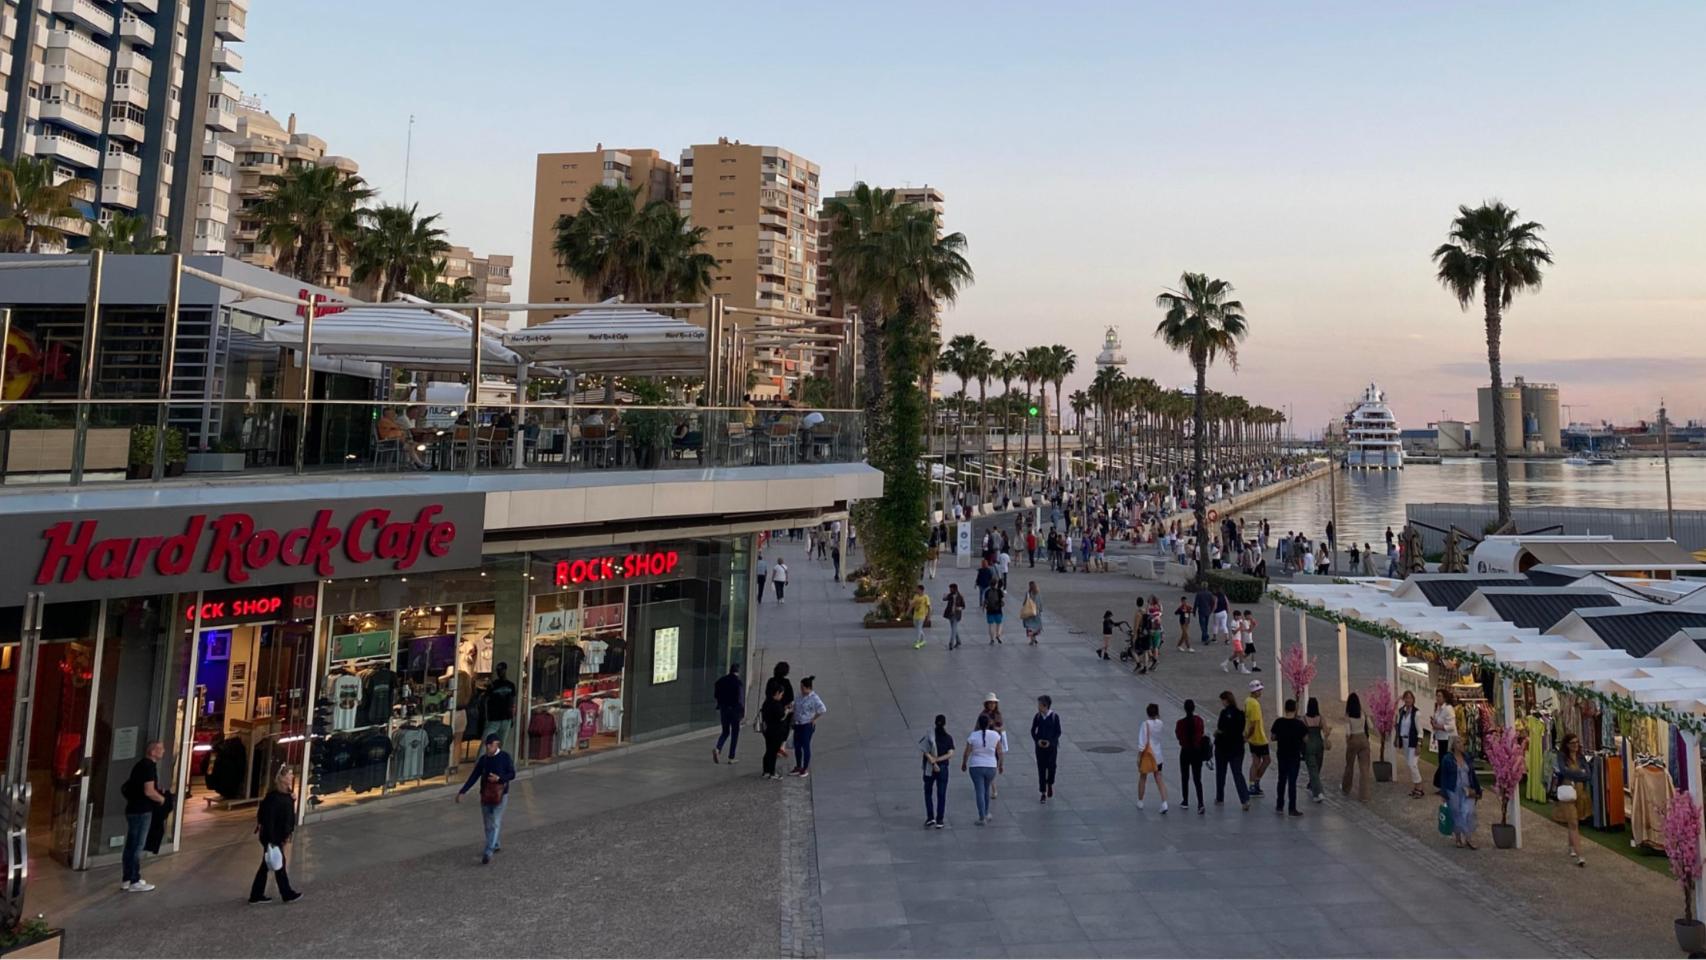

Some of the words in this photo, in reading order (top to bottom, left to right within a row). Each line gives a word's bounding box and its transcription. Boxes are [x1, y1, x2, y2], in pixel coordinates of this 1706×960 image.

[36, 513, 206, 585] Hard
[206, 508, 343, 583] Rock
[346, 503, 457, 570] Cafe
[555, 558, 616, 586] ROCK
[623, 550, 680, 578] SHOP
[231, 596, 282, 617] SHOP
